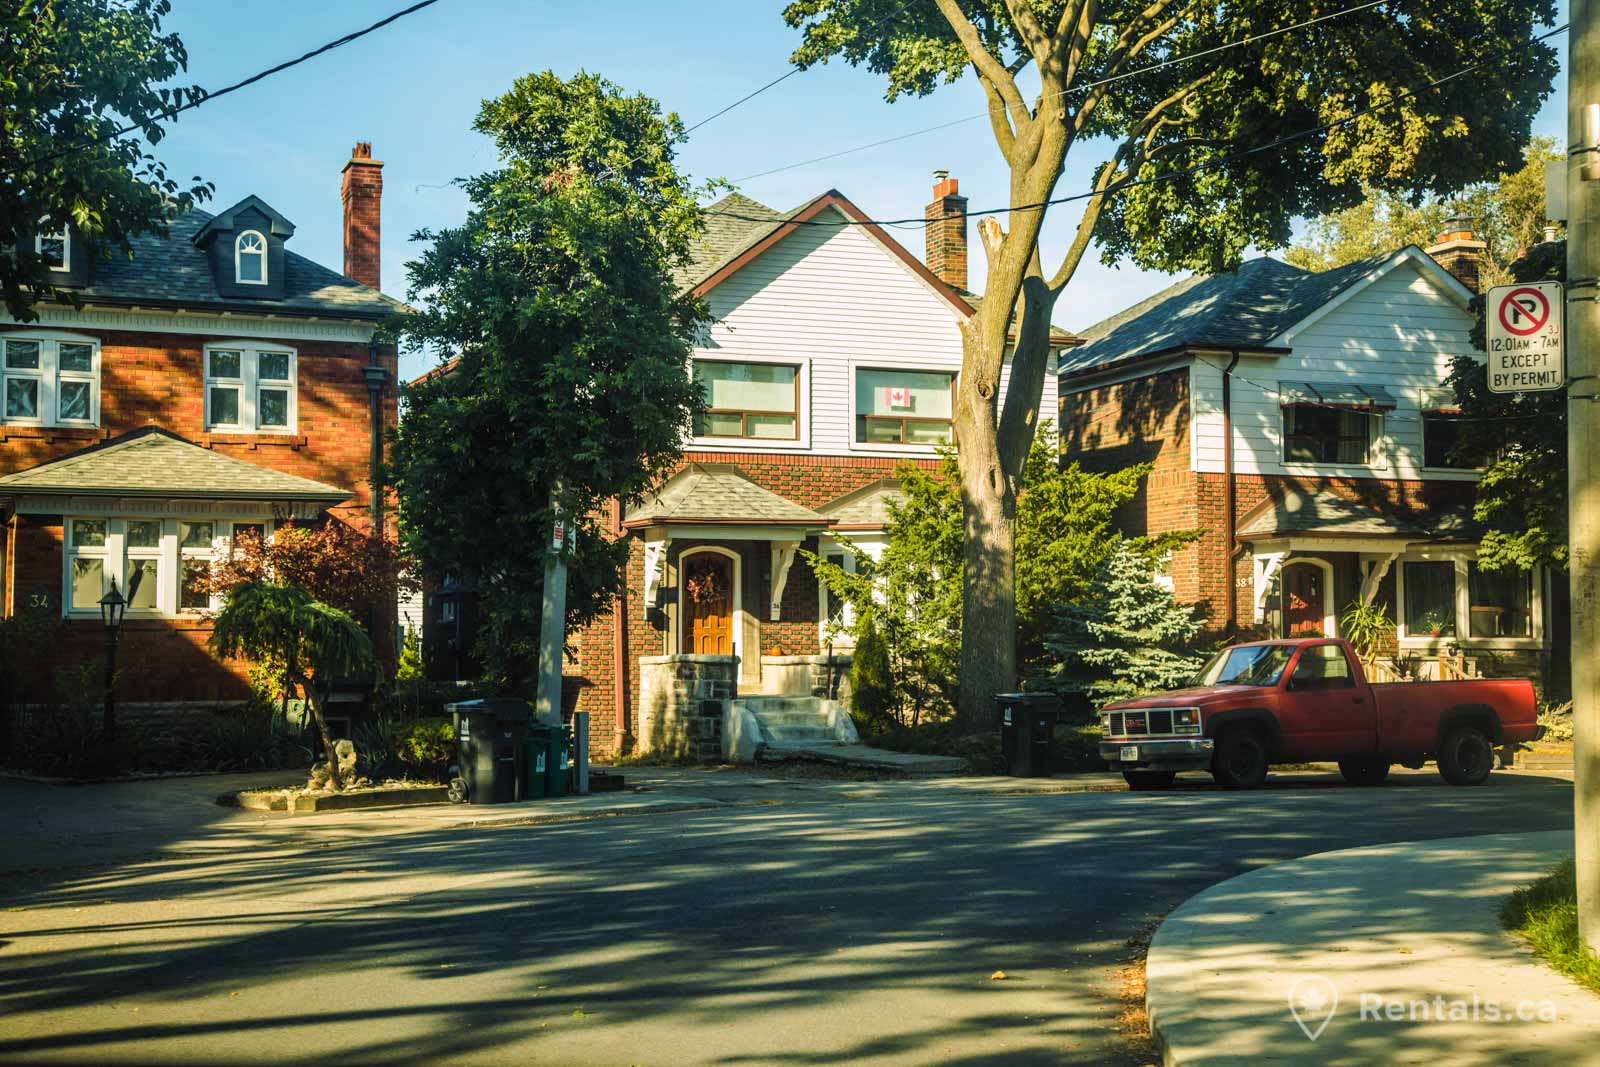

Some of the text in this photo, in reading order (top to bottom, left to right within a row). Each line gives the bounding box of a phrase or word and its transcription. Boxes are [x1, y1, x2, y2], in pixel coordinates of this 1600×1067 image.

[1490, 337, 1529, 352] 12:01AM
[1540, 335, 1559, 349] 7AM
[1501, 353, 1549, 369] EXCEPT
[1494, 370, 1557, 387] BY PERMIT
[31, 594, 48, 608] 34
